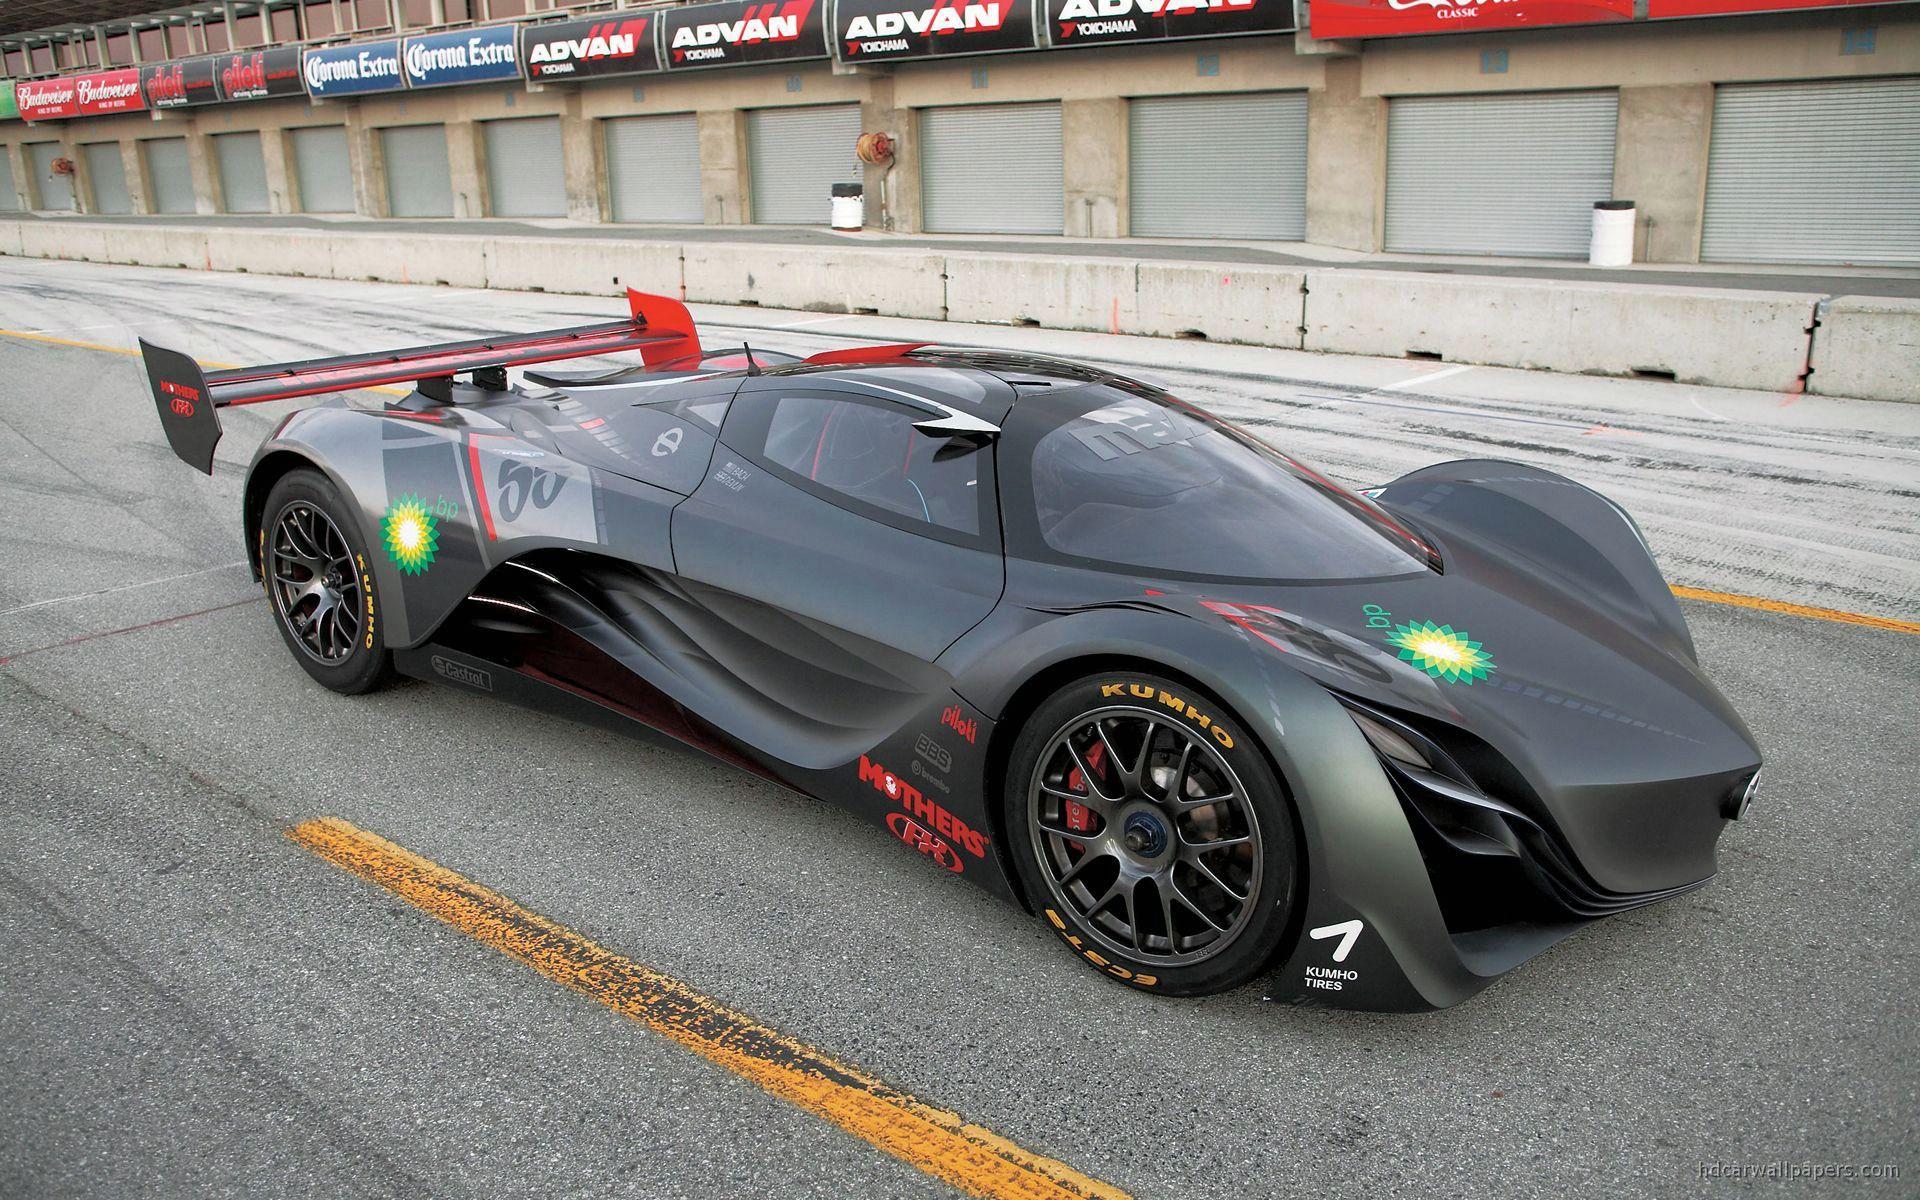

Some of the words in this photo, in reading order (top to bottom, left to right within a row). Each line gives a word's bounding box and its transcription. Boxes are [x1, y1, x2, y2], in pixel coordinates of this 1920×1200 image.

[845, 3, 1000, 40] ADVAN
[1077, 19, 1137, 36] YOKOHAMA
[1437, 7, 1479, 19] CLASSIC
[672, 15, 798, 48] ADVAN
[861, 38, 910, 53] YOKOHAMA
[407, 42, 468, 80] Corona
[468, 37, 515, 66] Extra
[530, 33, 634, 63] ADVAN
[684, 47, 726, 61] YOKOHAMA
[306, 56, 359, 90] Corona
[358, 52, 399, 77] Extra
[18, 86, 73, 110] Budweiser
[77, 79, 138, 105] Budweiser
[160, 380, 200, 404] MOTHERS
[436, 494, 459, 523] bp
[356, 553, 375, 650] KUMHO
[1362, 604, 1392, 629] bp
[445, 662, 486, 686] Castrol
[941, 703, 978, 745] piloti
[1101, 683, 1235, 749] KUMHO
[915, 732, 953, 774] BBS
[920, 766, 951, 795] brembo
[858, 753, 985, 859] MOTHERS
[1045, 909, 1158, 986] ECSTA
[1304, 977, 1343, 991] TIRES
[1306, 966, 1358, 981] KUMHO
